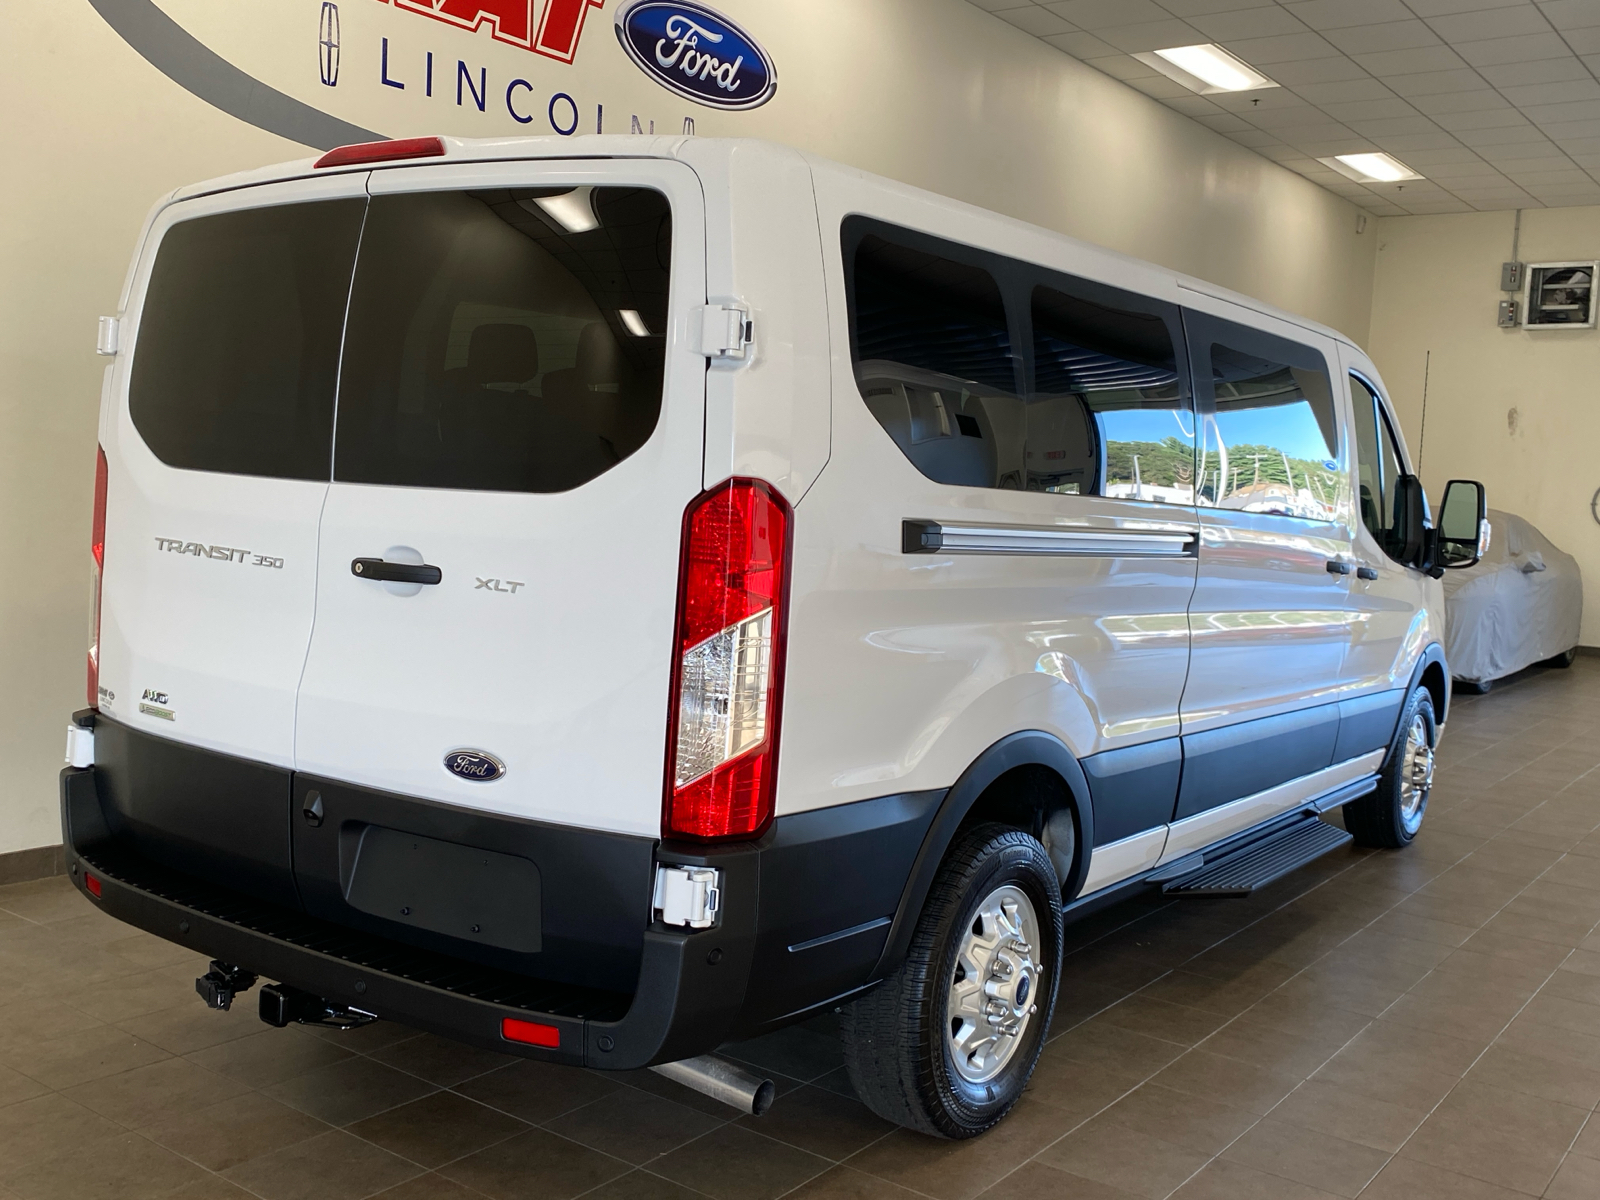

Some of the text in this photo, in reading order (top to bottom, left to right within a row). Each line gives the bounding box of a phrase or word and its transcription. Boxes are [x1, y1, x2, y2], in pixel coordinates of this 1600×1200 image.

[655, 14, 742, 92] Ford
[155, 537, 284, 569] TRANSIT 350
[474, 577, 525, 594] XLT
[453, 755, 487, 776] Ford
